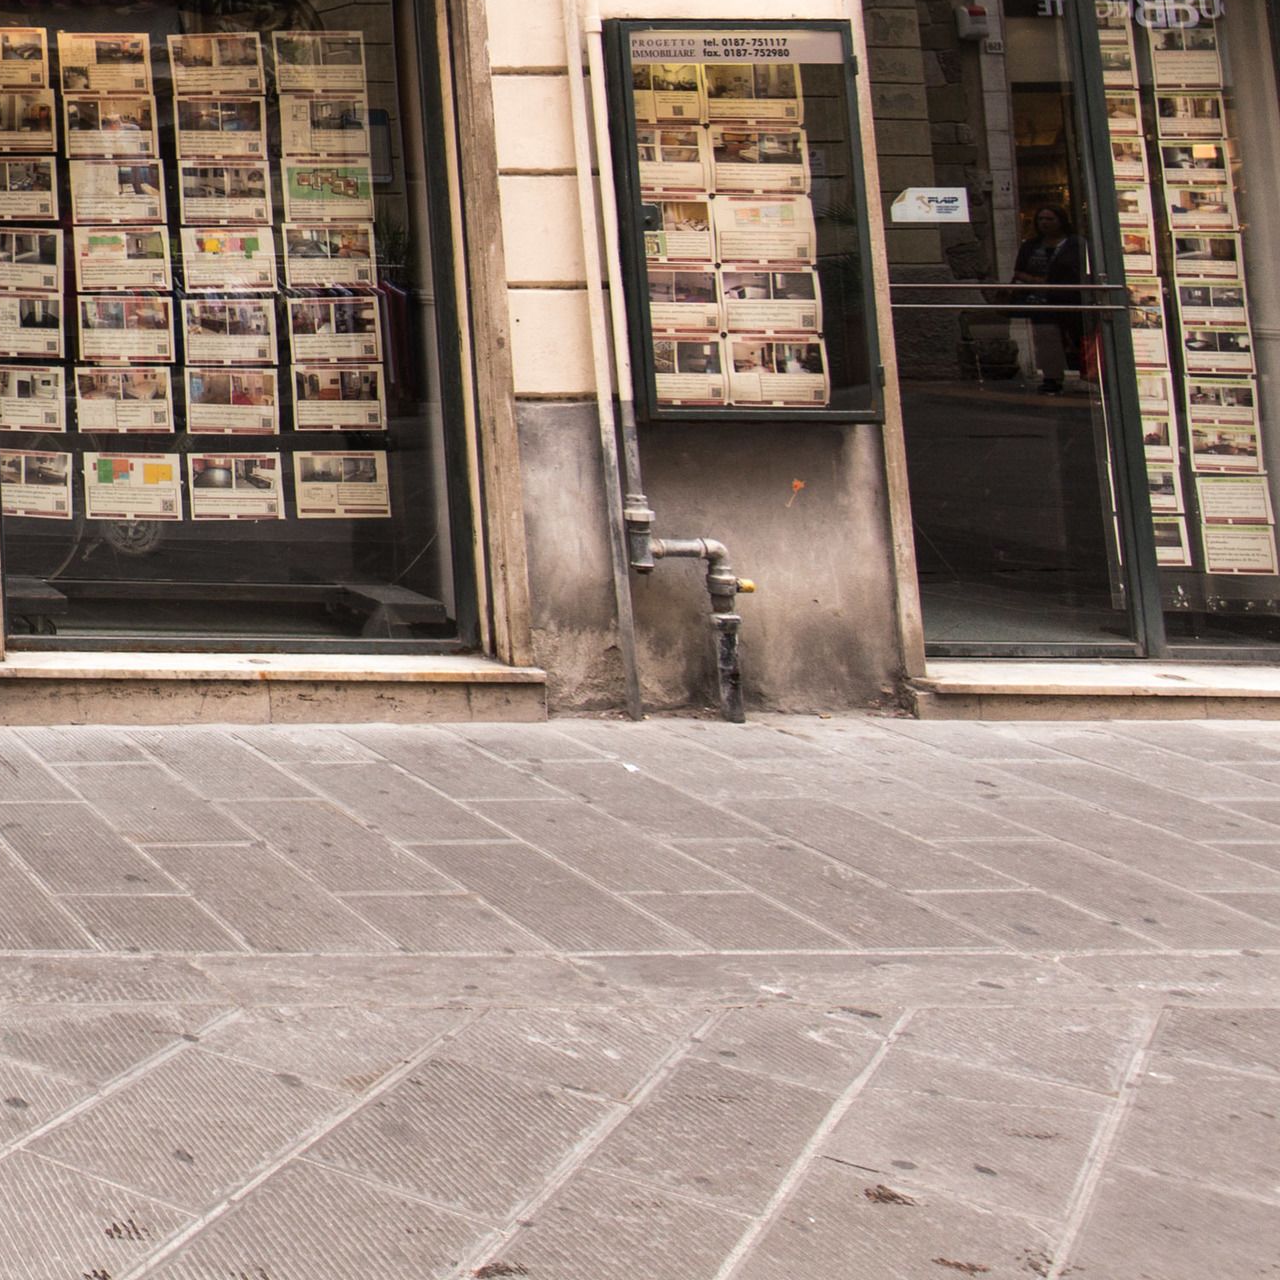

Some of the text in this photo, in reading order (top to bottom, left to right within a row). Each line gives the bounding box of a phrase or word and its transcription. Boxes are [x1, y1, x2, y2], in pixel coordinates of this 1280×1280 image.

[632, 37, 788, 47] PROGETTO tel. 0187-751117
[632, 48, 790, 58] IMMOBILIARE fax. 0187-752980
